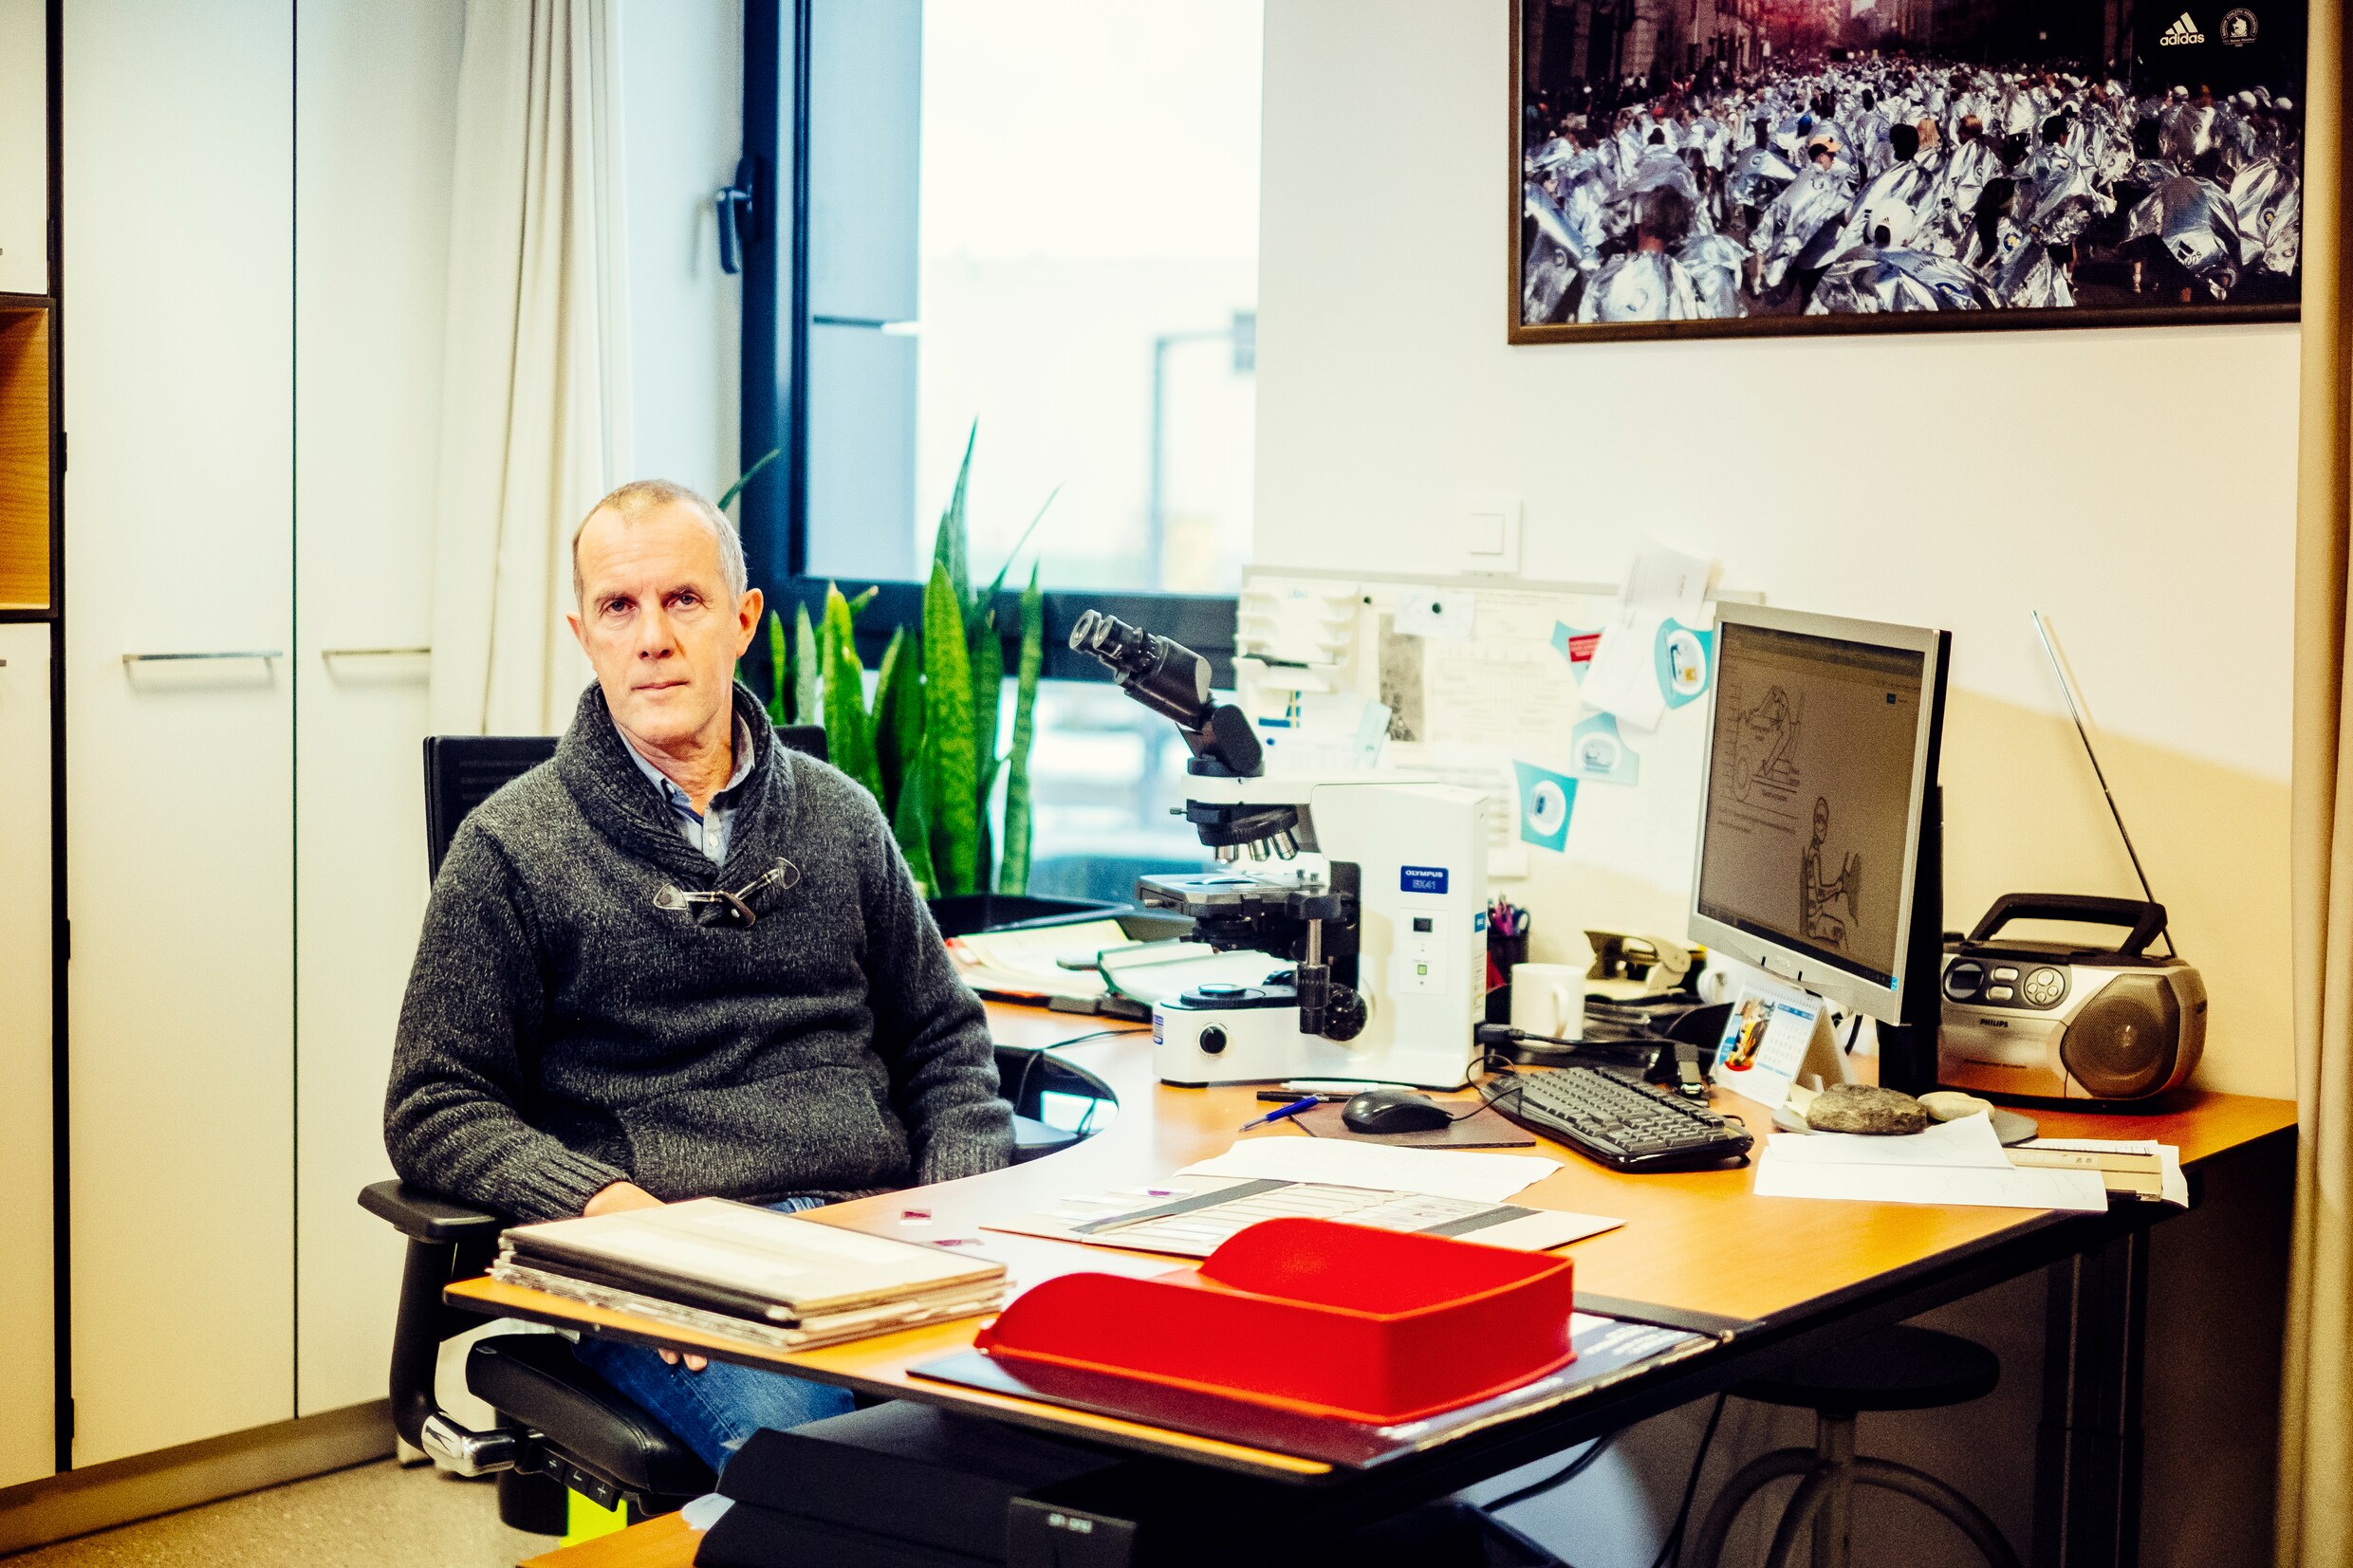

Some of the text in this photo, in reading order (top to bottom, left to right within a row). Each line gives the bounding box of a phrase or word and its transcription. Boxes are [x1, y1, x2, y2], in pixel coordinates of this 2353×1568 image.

[2159, 32, 2205, 46] adidas
[1405, 870, 1443, 878] OLYMPUS
[1980, 1018, 2009, 1028] PHILIPS
